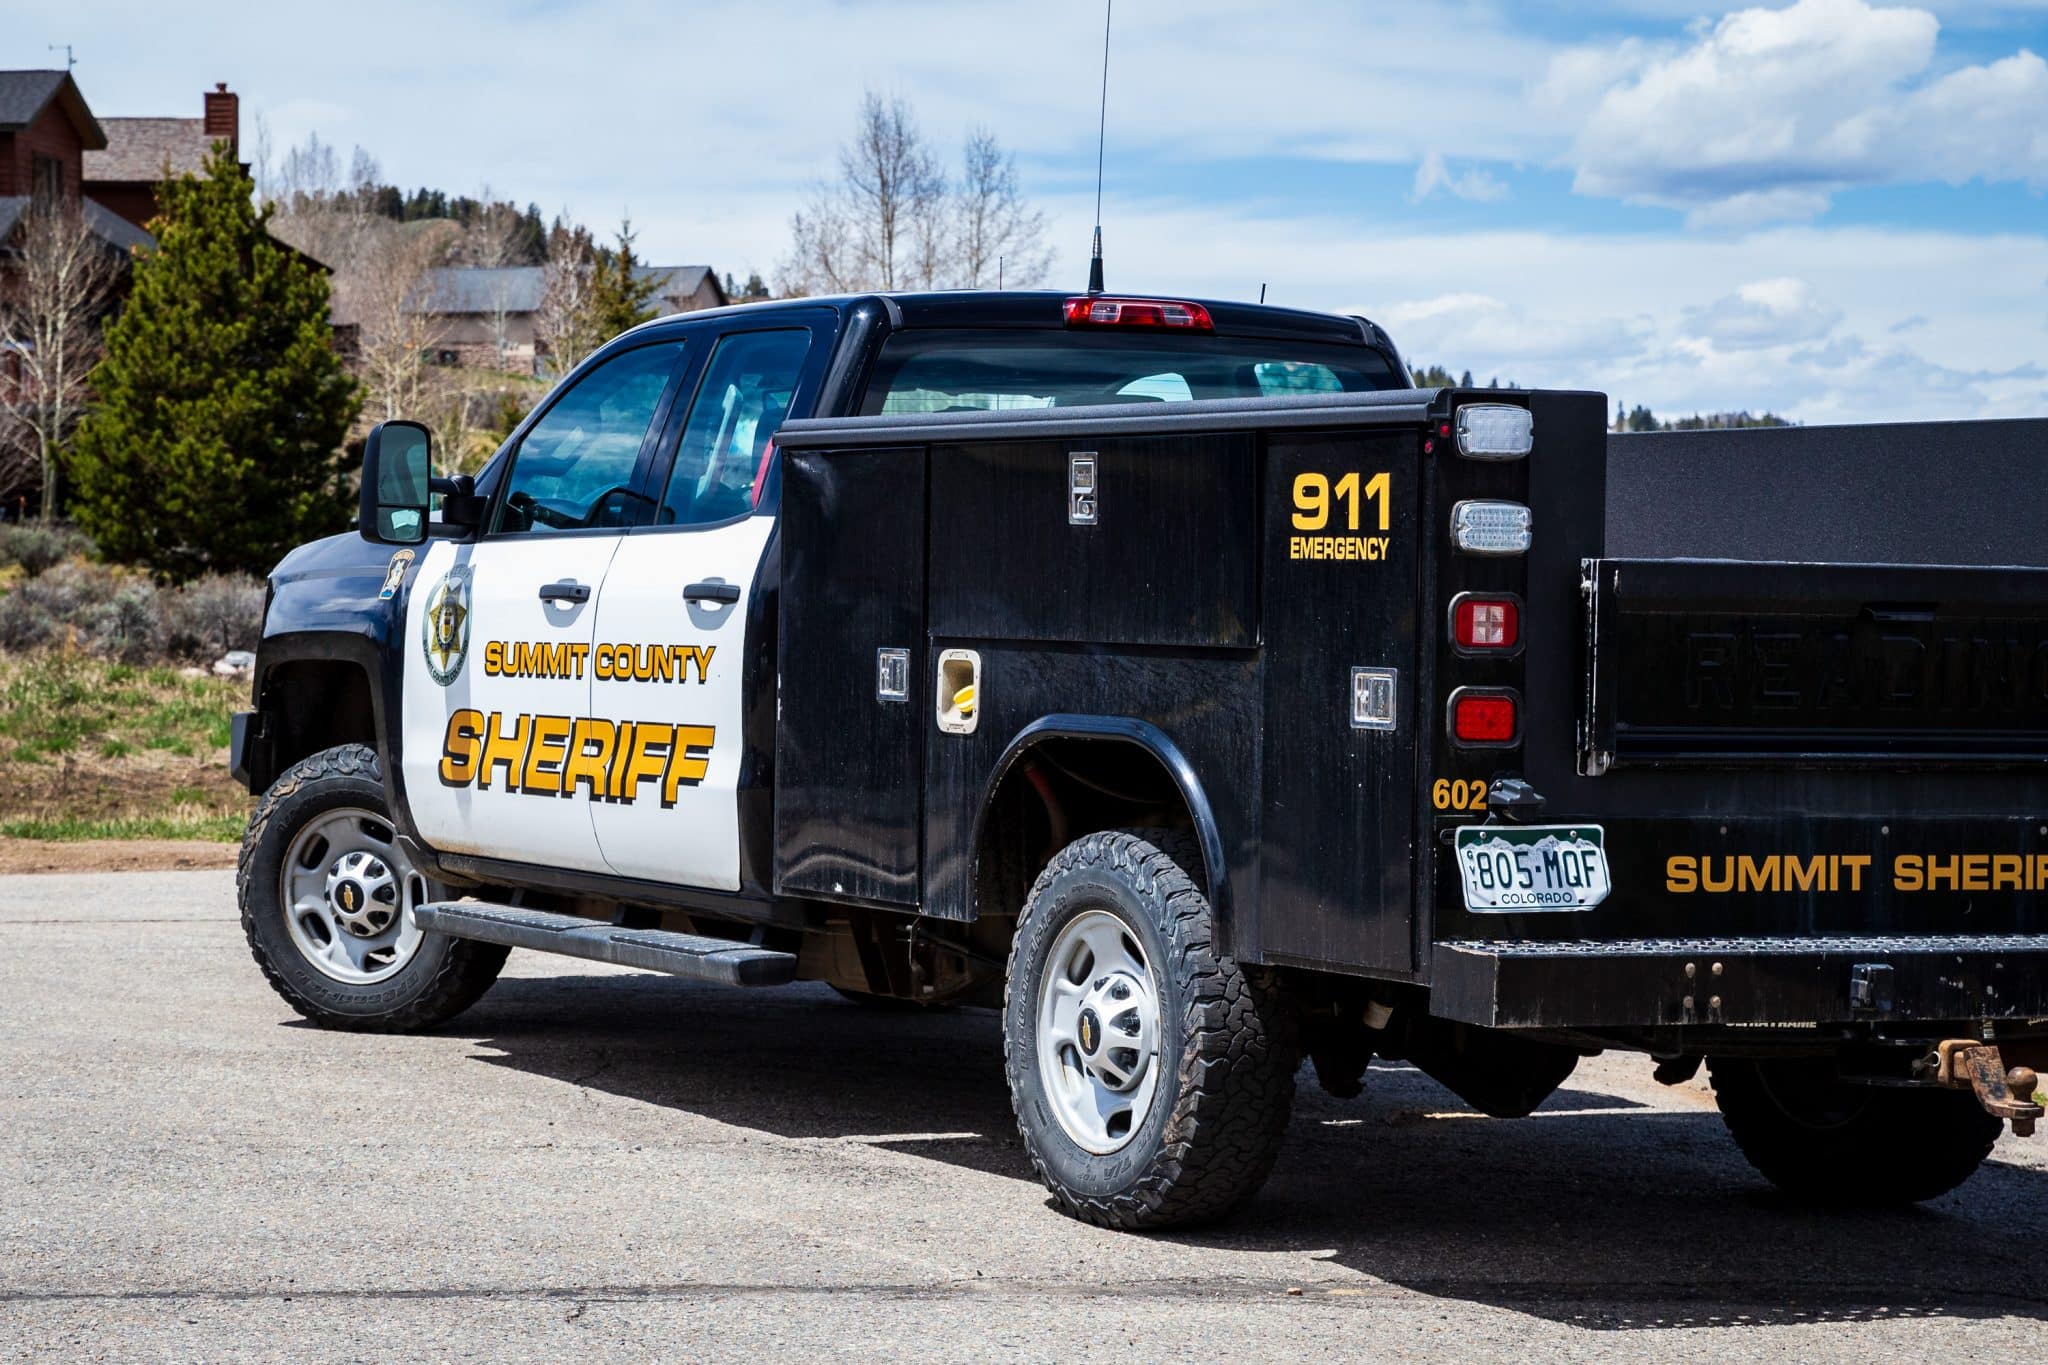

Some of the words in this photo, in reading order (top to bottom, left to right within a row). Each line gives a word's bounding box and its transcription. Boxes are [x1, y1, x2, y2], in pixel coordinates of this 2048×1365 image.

[1291, 472, 1391, 531] 911
[1290, 536, 1390, 560] EMERGENCY
[484, 641, 590, 679] SUMMIT
[594, 643, 716, 684] COUNTY
[1686, 632, 2048, 712] READIN
[438, 708, 716, 809] SHERIFF
[1432, 778, 1488, 811] 602
[1666, 855, 1871, 893] SUMMIT
[1501, 892, 1573, 905] COLORADO
